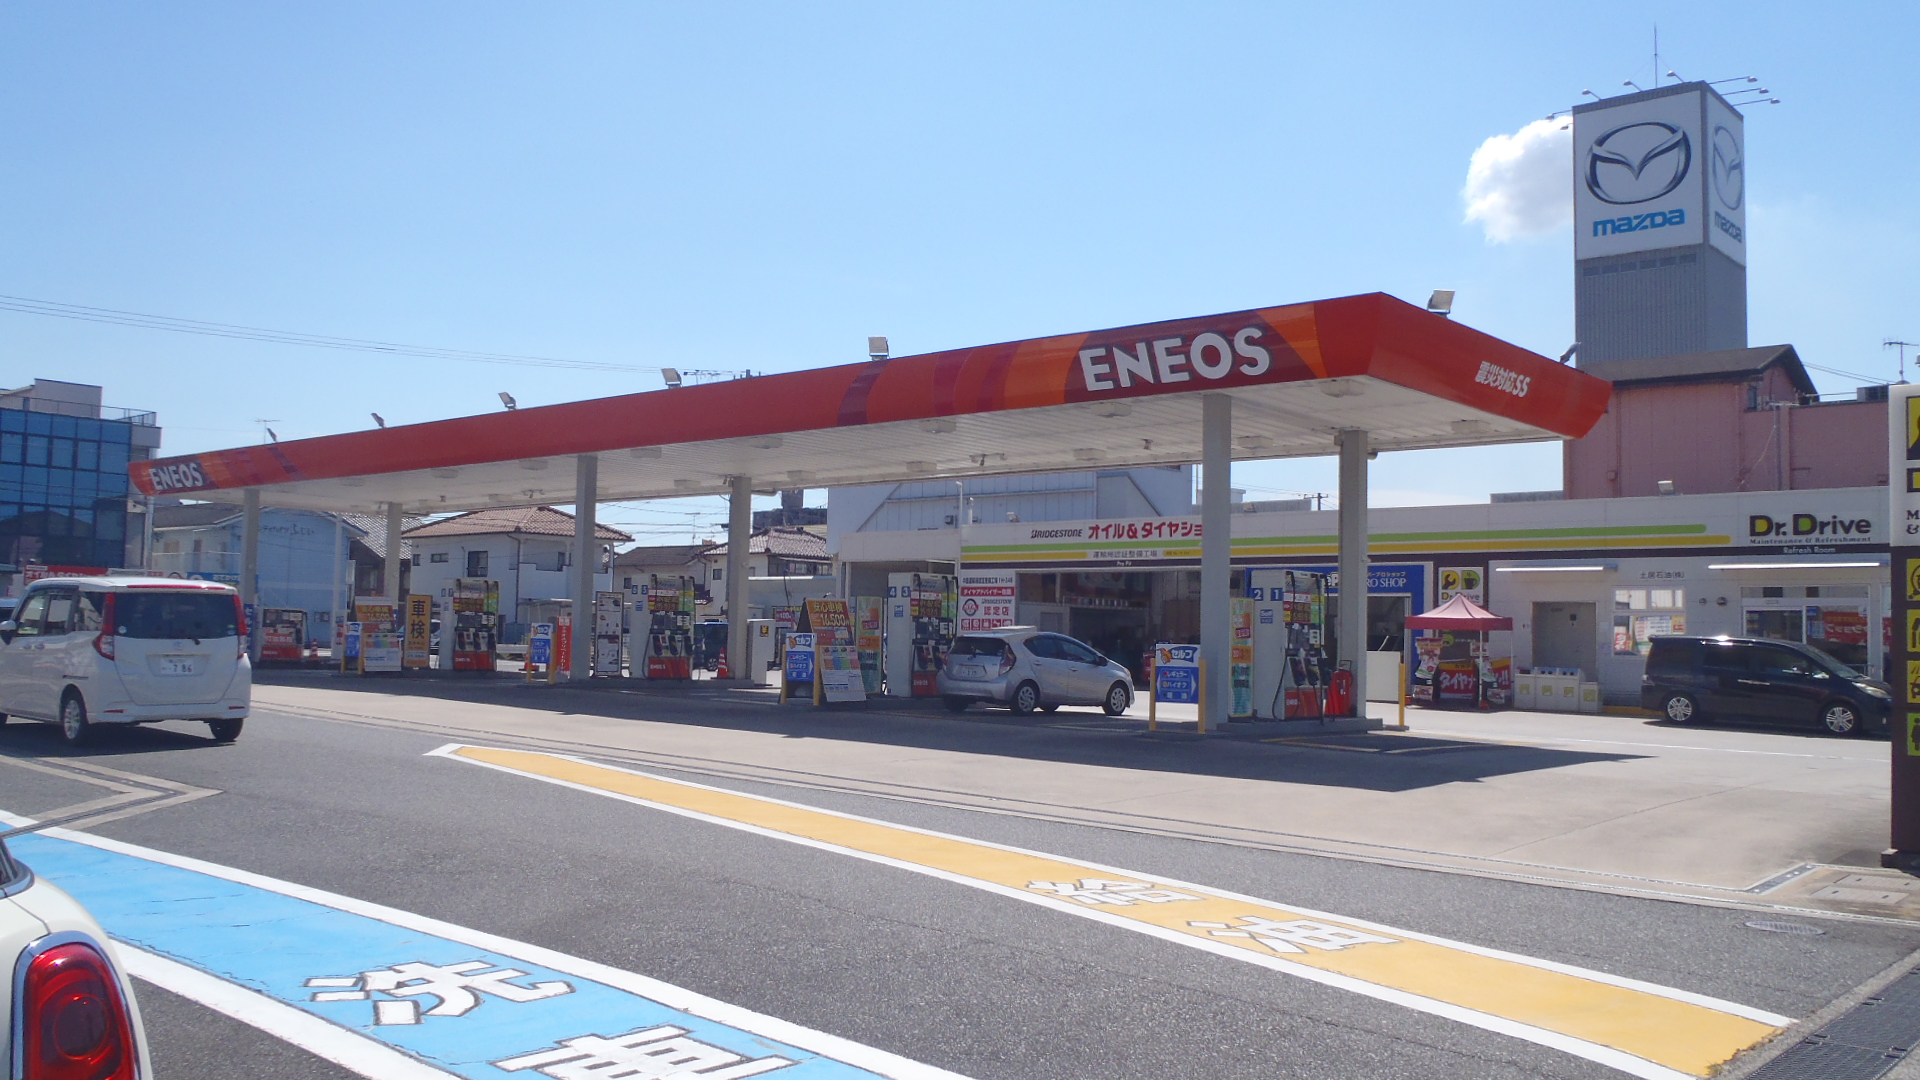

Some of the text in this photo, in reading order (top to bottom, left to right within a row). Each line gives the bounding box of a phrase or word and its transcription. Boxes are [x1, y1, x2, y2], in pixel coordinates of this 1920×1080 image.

[1593, 208, 1685, 237] mazda
[1714, 210, 1742, 243] mazda
[1078, 326, 1271, 391] ENEOS
[148, 462, 204, 491] ENEOS
[1749, 513, 1872, 537] Dr. Drive
[1030, 528, 1083, 539] BRIDGESTONE
[1380, 577, 1407, 588] SHOP
[889, 588, 896, 597] 4
[903, 588, 909, 597] 3
[1254, 589, 1261, 599] 2
[1274, 589, 1279, 599] 1
[411, 600, 426, 639] 車検
[796, 636, 811, 645] セルフ
[1171, 649, 1193, 659] セルフ
